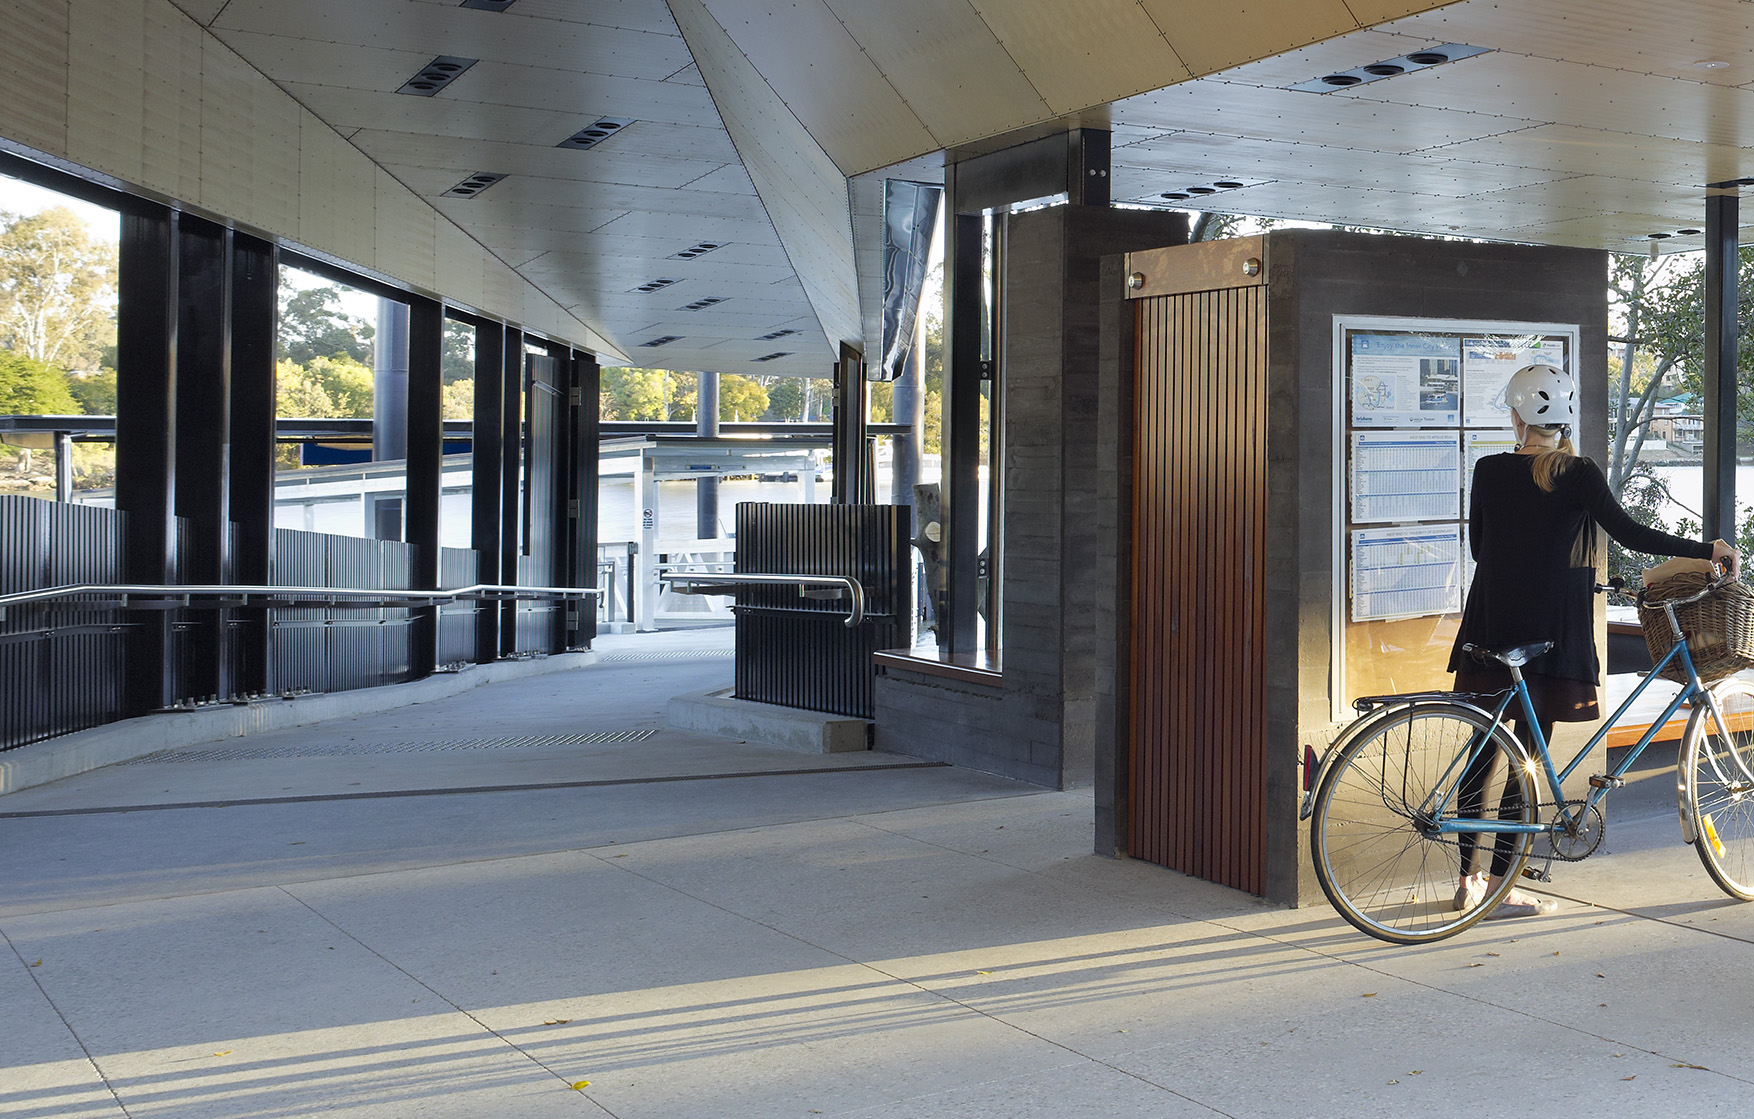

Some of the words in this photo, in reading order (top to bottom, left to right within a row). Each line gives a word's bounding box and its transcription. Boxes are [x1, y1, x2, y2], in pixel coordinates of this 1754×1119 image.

[1376, 341, 1393, 351] Enjoy
[1394, 341, 1405, 349] the
[1406, 342, 1421, 350] Inner
